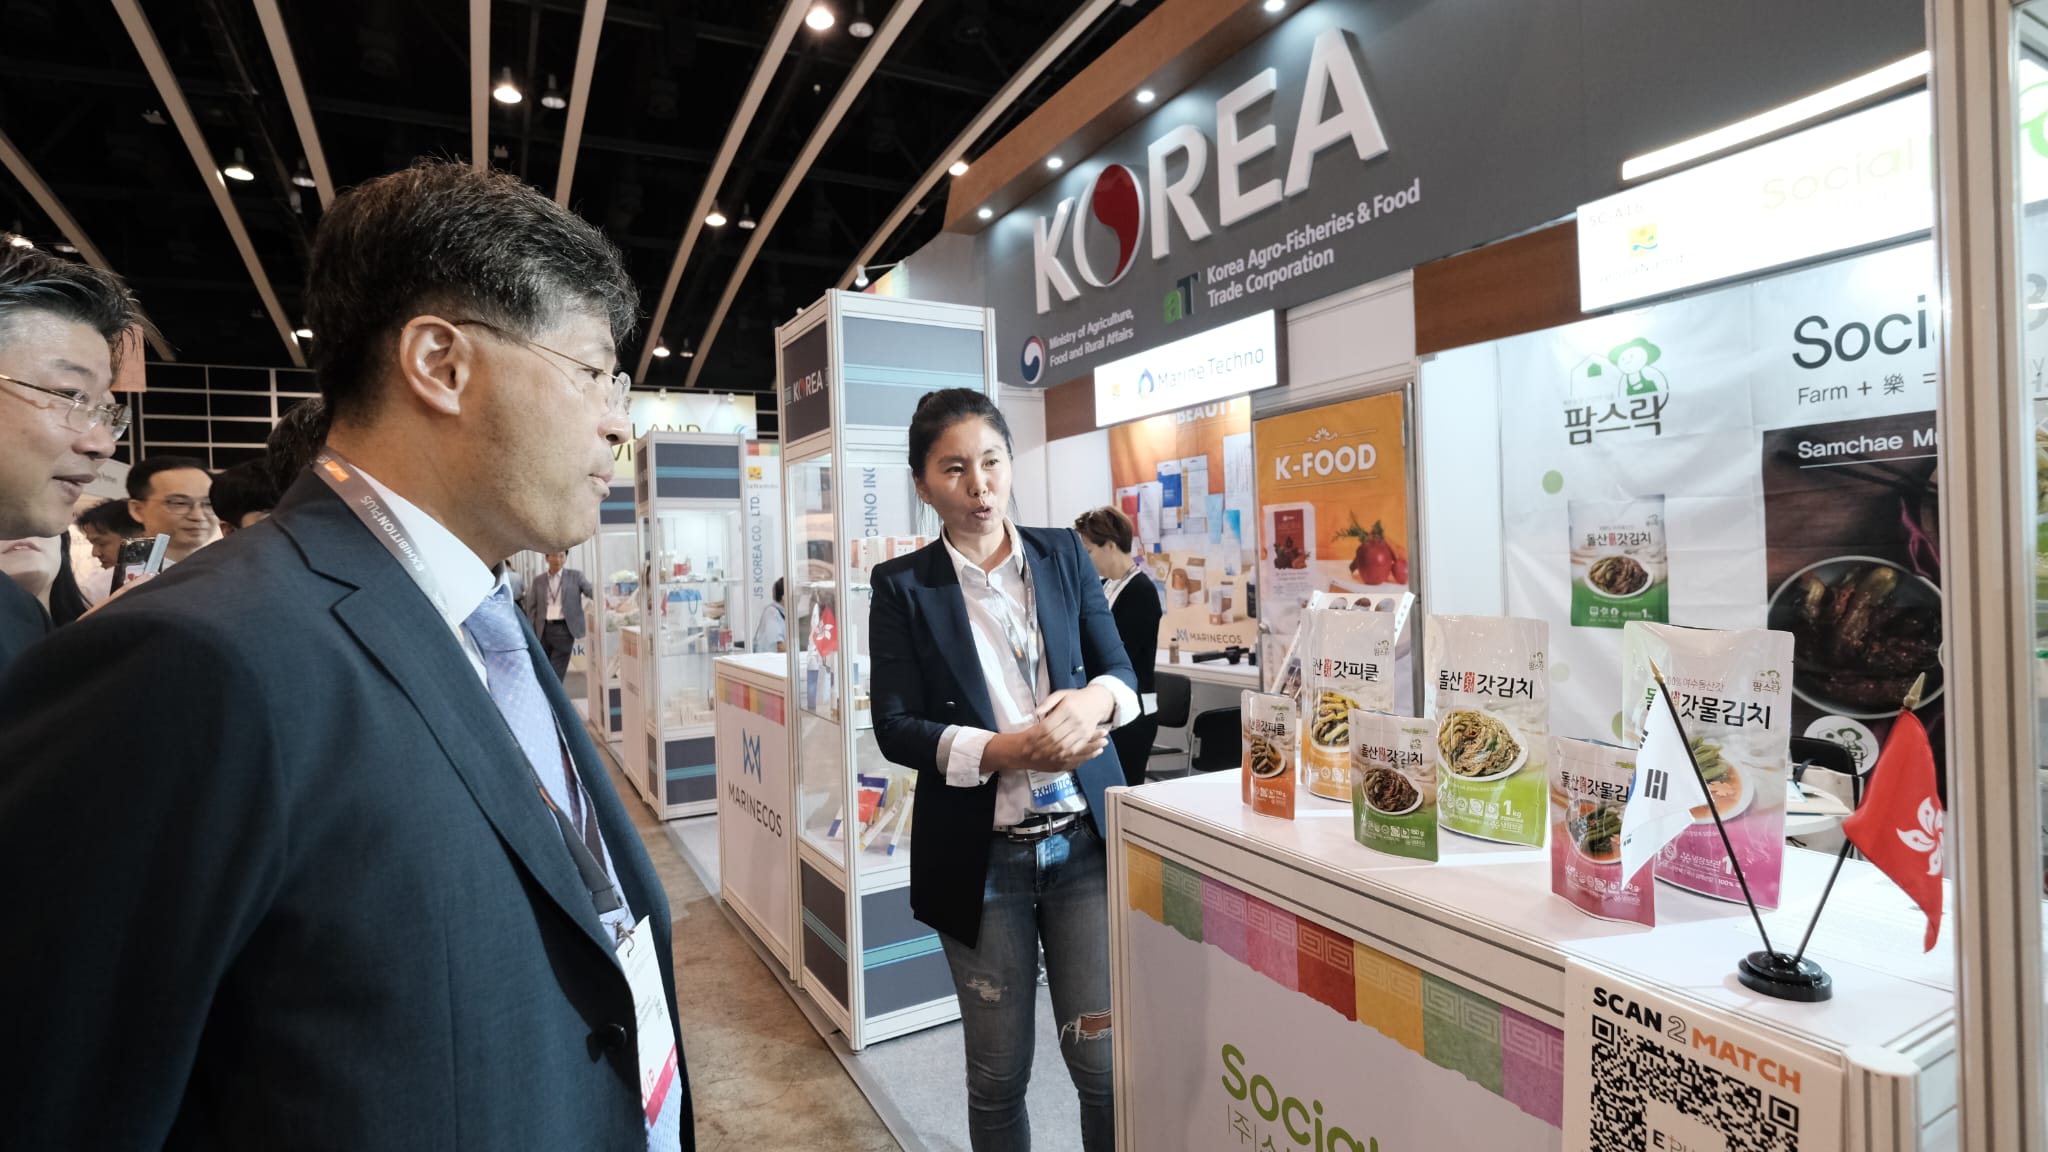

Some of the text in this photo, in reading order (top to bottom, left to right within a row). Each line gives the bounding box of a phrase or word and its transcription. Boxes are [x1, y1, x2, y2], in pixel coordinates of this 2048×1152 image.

[1034, 27, 1389, 315] KOREA
[1207, 177, 1421, 285] Korea Agro-Fisheries & Food
[1207, 247, 1334, 308] Trade Corporation
[1049, 308, 1134, 350] Ministry of Agriculture,
[1792, 294, 1936, 369] Soci
[1050, 328, 1134, 367] Food and Rural Affairs
[793, 369, 823, 402] KOREA
[1158, 348, 1264, 390] Marine Techno
[1798, 384, 1848, 406] Farm
[1883, 373, 1904, 395] 樂
[1563, 395, 1663, 446] 팜스락
[1275, 443, 1377, 481] K-FOOD
[1798, 435, 1903, 459] Samchae
[1616, 531, 1652, 546] 갓김치
[752, 544, 763, 584] KOREA
[754, 586, 764, 600] JS
[1189, 632, 1243, 644] MARINECOS
[1333, 660, 1379, 682] 갓피클
[1439, 669, 1463, 691] 돌산
[1476, 673, 1534, 700] 갓김치
[1752, 681, 1781, 695] 팜스락
[1681, 693, 1771, 730] 갓물김치
[1387, 749, 1423, 767] 갓김치
[1031, 775, 1078, 800] EXHIBITOR
[728, 783, 783, 838] MARINECOS
[1503, 800, 1512, 816] 1
